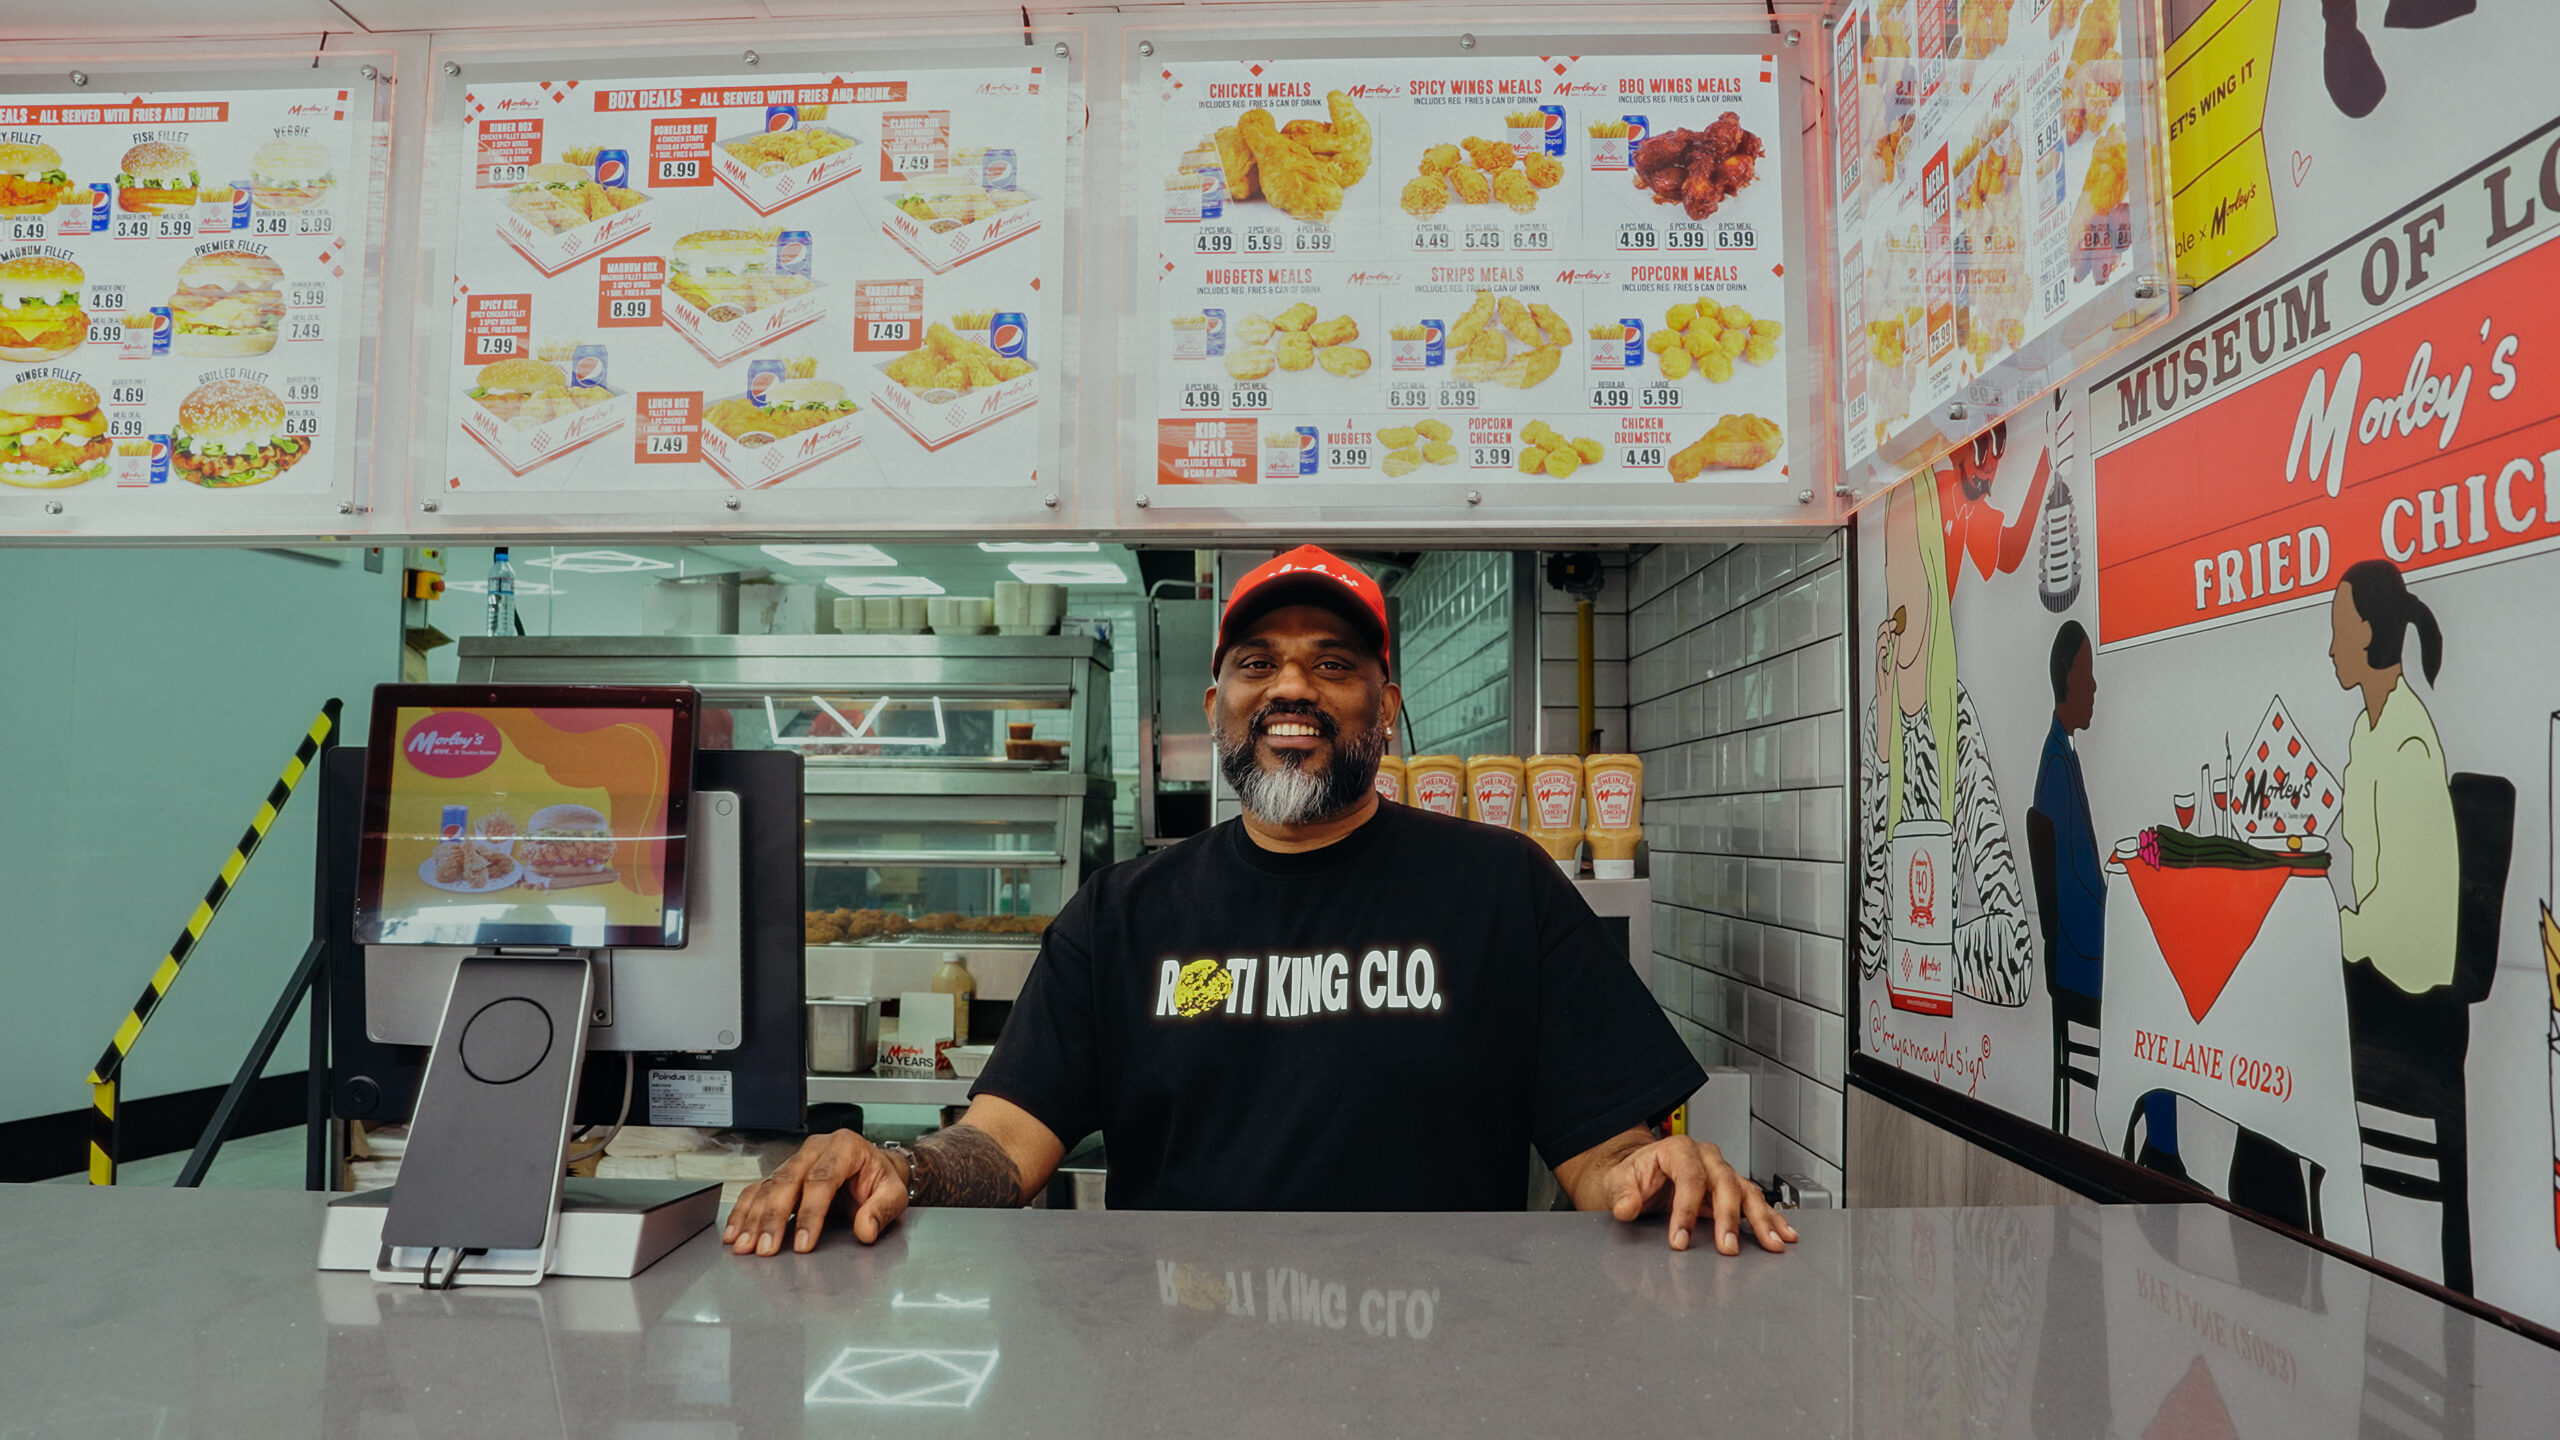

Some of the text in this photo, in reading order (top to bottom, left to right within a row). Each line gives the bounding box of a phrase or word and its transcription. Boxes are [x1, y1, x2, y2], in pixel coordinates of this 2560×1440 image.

[1210, 82, 1311, 99] CHICKEN MEALS
[1347, 84, 1401, 99] Morley's
[1410, 79, 1542, 95] SPICY WINGS MEALS
[1553, 82, 1607, 96] Morley's
[1619, 78, 1741, 95] BBQ WINGS MEALS
[609, 87, 890, 110] BOX DEALS ALL SERVED WITH FRIES AND DRINK
[2170, 58, 2255, 141] ET'S WING IT
[0, 107, 219, 123] EALS ALL SERVED WITH FRIES AND DRINK
[518, 122, 532, 131] BOX
[655, 125, 708, 135] BONELESS BOX
[11, 134, 42, 145] FILLET
[133, 131, 189, 144] FISH FILLET
[2038, 119, 2058, 156] 5.99
[493, 166, 524, 180] 8.99
[664, 163, 695, 177] 8.99
[1926, 161, 1944, 200] MEGA
[256, 218, 287, 234] 3.49
[2175, 231, 2194, 258] ble
[2211, 181, 2256, 240] Morley's
[14, 224, 44, 239] 6.49
[118, 223, 148, 236] 3.49
[161, 221, 191, 235] 5.99
[1198, 236, 1232, 250] 4.99
[1248, 235, 1282, 250] 5.99
[1296, 234, 1330, 250] 6.99
[1416, 233, 1449, 248] 4.49
[1465, 232, 1500, 248] 5.49
[1514, 232, 1548, 248] 6.49
[1620, 233, 1655, 247] 4.99
[1669, 232, 1703, 247] 5.99
[1719, 232, 1754, 246] 6.99
[1, 245, 74, 262] MAGNUM FILLET
[194, 239, 268, 256] PREMIER FILLET
[643, 262, 657, 272] BOX
[1432, 267, 1524, 282] STRIPS MEALS
[1632, 266, 1737, 281] POPCORN MEALS
[1207, 269, 1312, 284] NUGGETS MEALS
[1556, 270, 1610, 284] Morley's
[92, 293, 123, 309] 4.69
[293, 290, 324, 306] 5.99
[2045, 279, 2065, 312] 6.49
[480, 299, 518, 310] SPICY BOX
[614, 302, 645, 316] 8.99
[2117, 270, 2330, 431] MUSEUM
[2361, 204, 2445, 307] OF
[90, 325, 121, 342] 6.99
[291, 324, 320, 339] 7.49
[873, 324, 903, 338] 7.49
[1930, 322, 1951, 354] 25.99
[483, 338, 512, 353] 7.99
[15, 368, 82, 385] RINGER FILLET
[199, 368, 269, 385] GRILLED FILLET
[112, 387, 144, 403] 4.69
[288, 385, 318, 400] 4.99
[1185, 392, 1220, 407] 4.99
[1232, 392, 1267, 407] 5.99
[1391, 391, 1426, 406] 6.99
[1441, 391, 1476, 406] 8.99
[1594, 390, 1628, 406] 4.99
[1643, 390, 1678, 405] 5.99
[648, 398, 690, 408] LUNCH BOX
[2285, 316, 2519, 498] Morley's
[111, 420, 142, 436] 6.99
[286, 418, 317, 434] 6.49
[1196, 422, 1226, 438] KIDS
[1347, 419, 1352, 430] 4
[1469, 418, 1512, 429] POPCORN
[1622, 418, 1664, 428] CHICKEN
[653, 437, 682, 452] 7.49
[1328, 432, 1372, 444] NUGGETS
[1470, 432, 1512, 444] CHICKEN
[1614, 432, 1672, 444] DRUMSTICK
[1188, 440, 1233, 457] MEALS
[1332, 450, 1367, 465] 3.99
[1475, 449, 1510, 465] 3.99
[1626, 449, 1660, 464] 4.49
[2194, 525, 2331, 611] FRIED
[408, 731, 484, 755] Morley's
[1424, 778, 1449, 787] HEINZ
[1484, 778, 1509, 786] HEINZ
[1542, 776, 1567, 785] HEINZ
[1601, 777, 1626, 785] HEINZ
[1915, 870, 1927, 894] 40
[1919, 954, 1941, 981] Morley's
[1266, 953, 1349, 1018] KING
[1359, 948, 1441, 1010] CLO.
[880, 1055, 934, 1067] 40 YEARS
[2134, 1029, 2293, 1104] RYE LANE (2023)
[653, 1072, 686, 1080] Poindus
